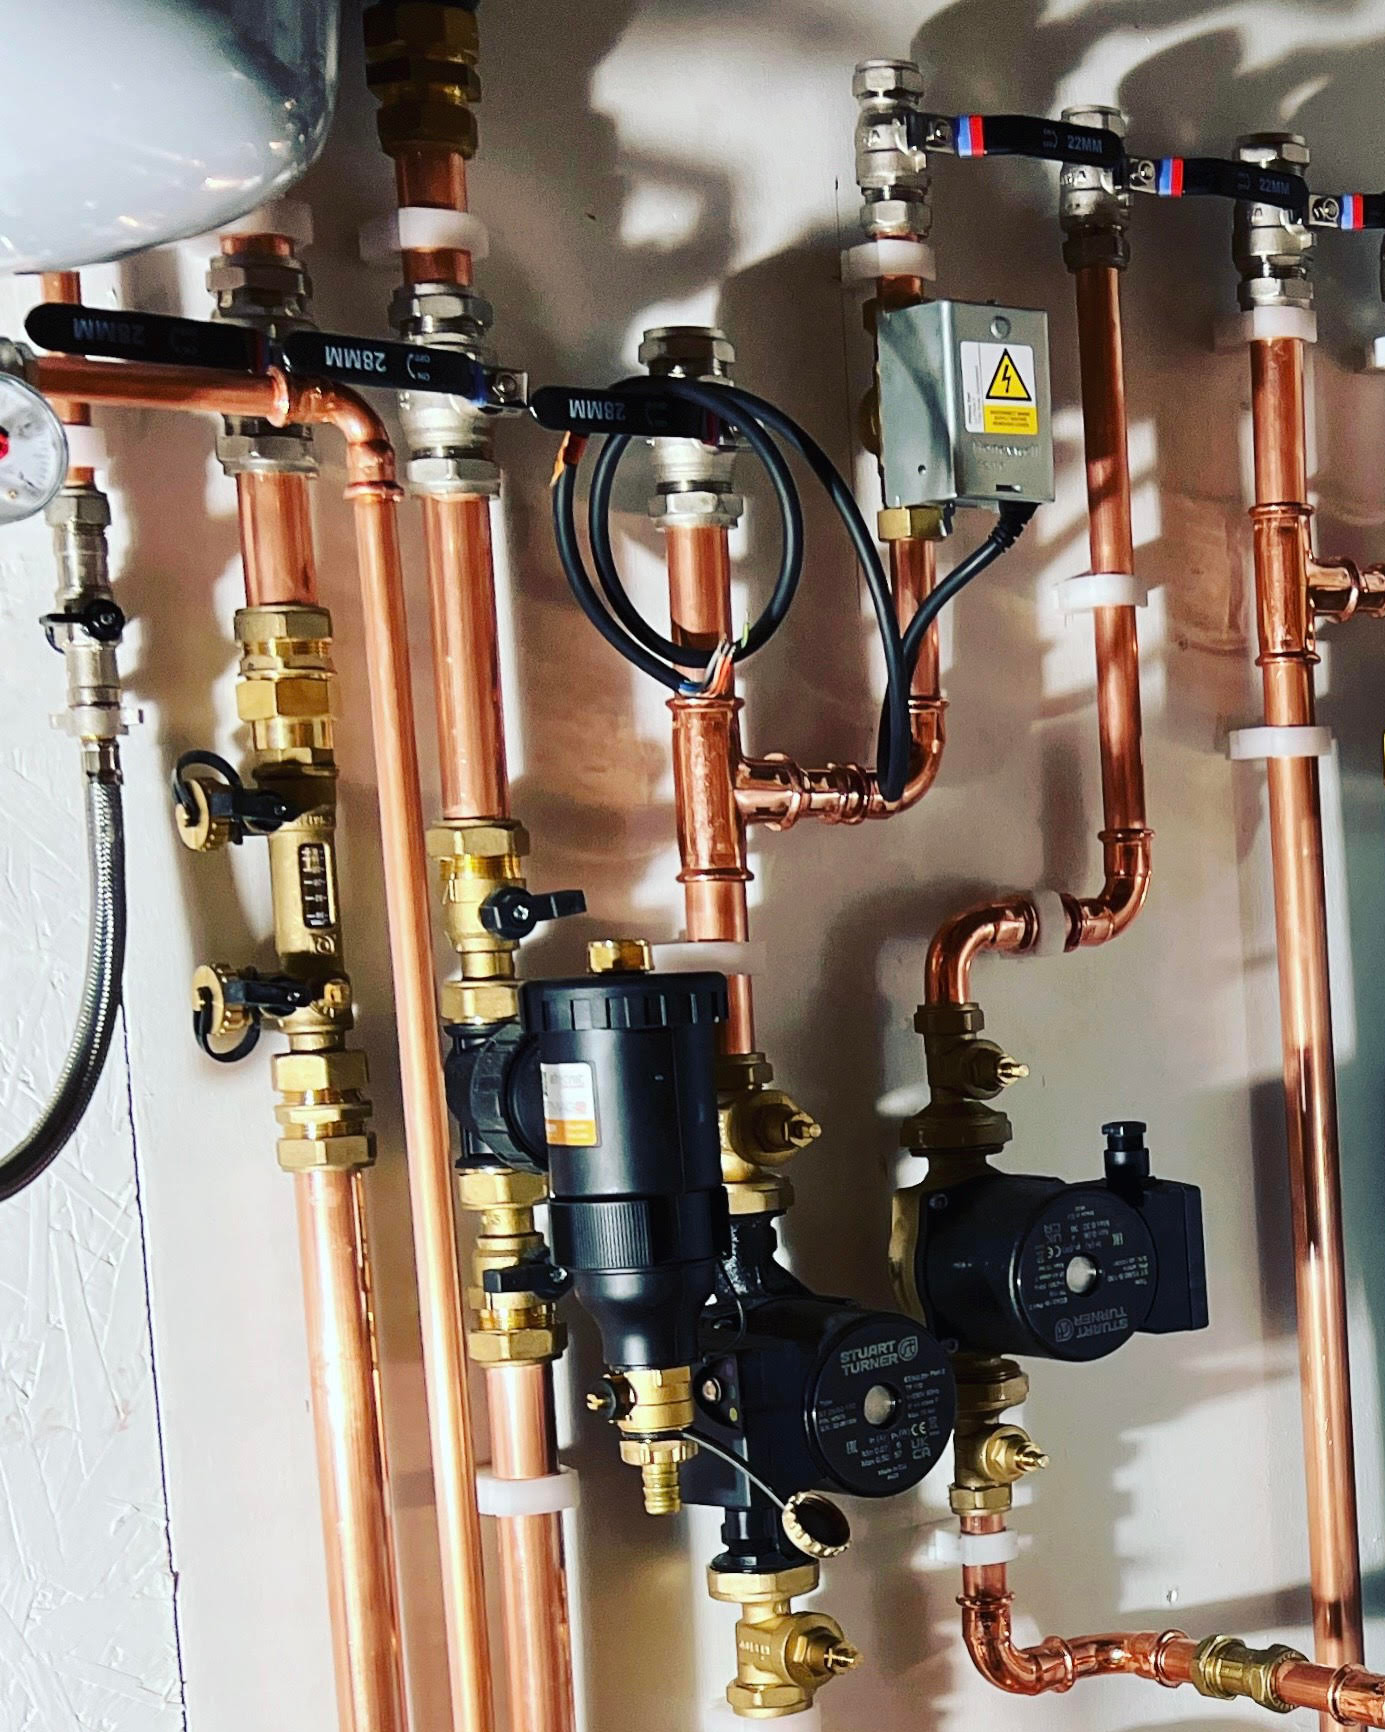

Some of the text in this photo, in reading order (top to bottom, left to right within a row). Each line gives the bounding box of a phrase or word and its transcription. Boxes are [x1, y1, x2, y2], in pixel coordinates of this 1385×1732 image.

[1067, 134, 1104, 155] 22MM
[1258, 176, 1291, 196] 22MM
[325, 346, 388, 372] 28MM
[568, 398, 626, 421] 28MM
[1073, 1306, 1128, 1326] TURNER
[1075, 1318, 1129, 1339] STUART
[840, 1340, 897, 1364] STUART
[840, 1352, 899, 1377] TURNER
[911, 1421, 927, 1436] CE
